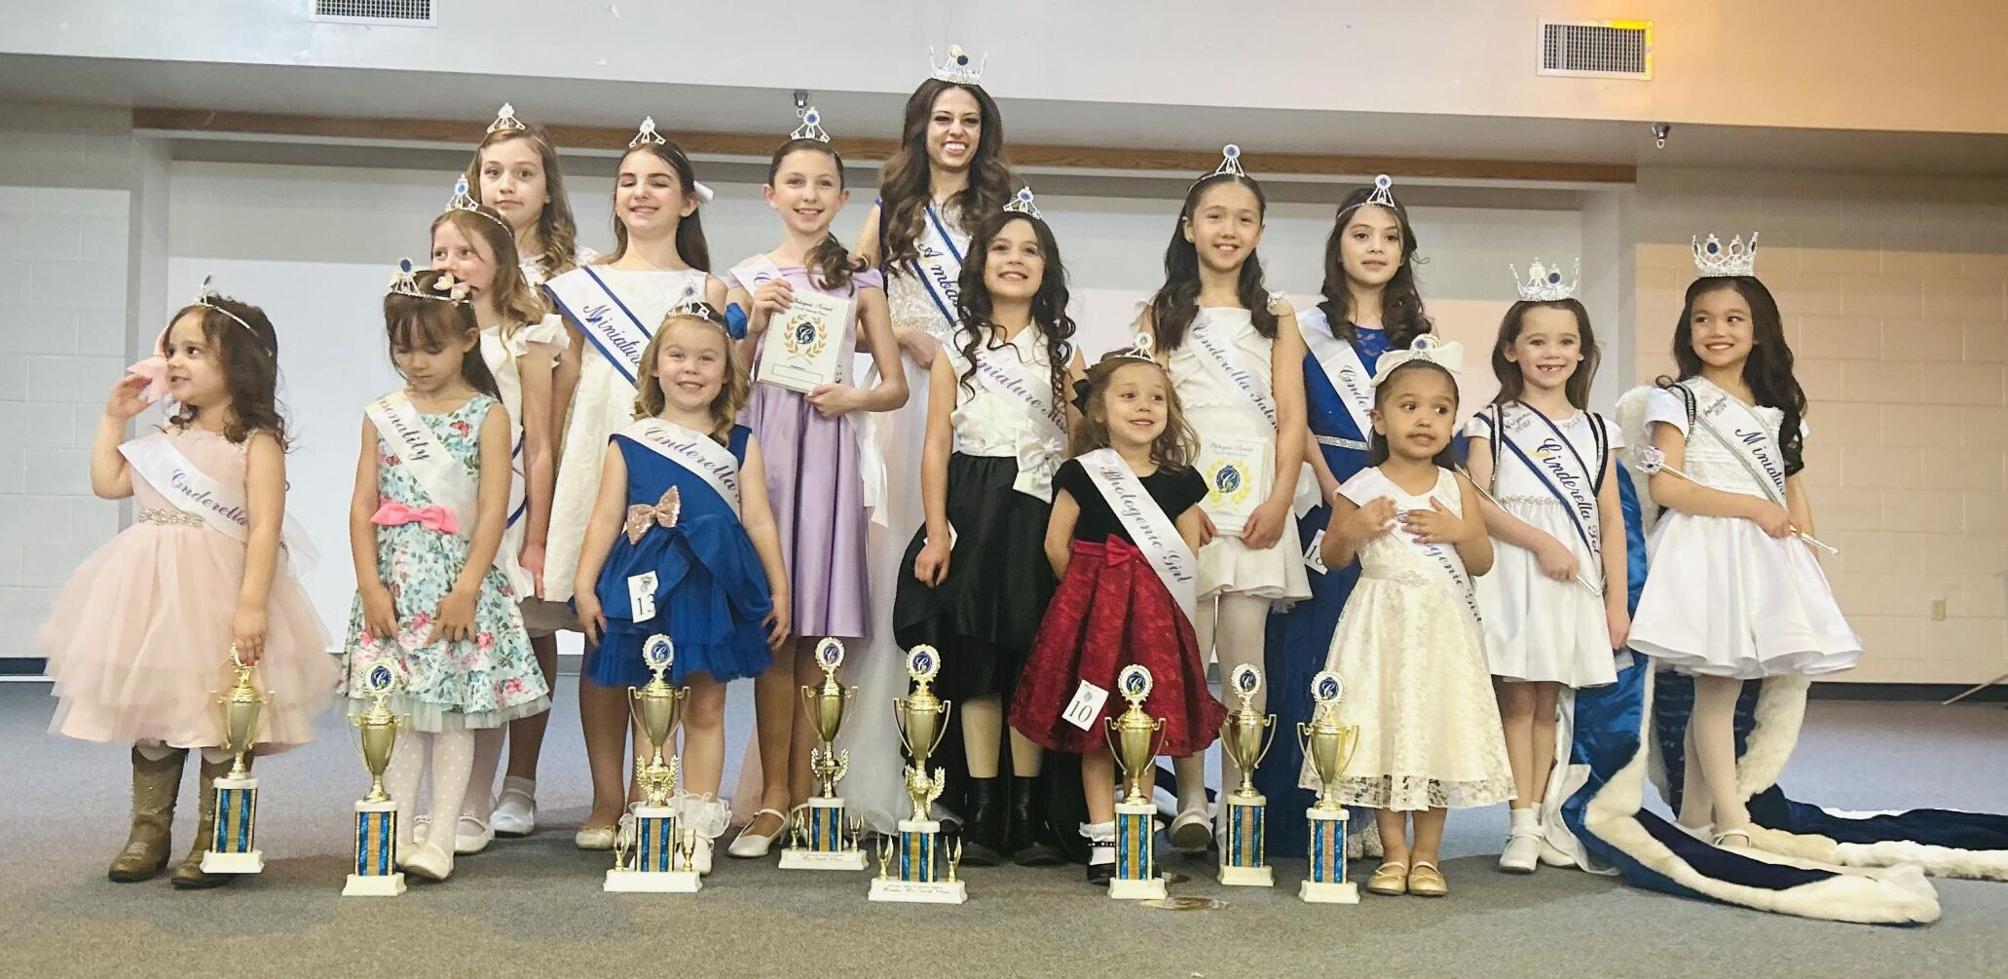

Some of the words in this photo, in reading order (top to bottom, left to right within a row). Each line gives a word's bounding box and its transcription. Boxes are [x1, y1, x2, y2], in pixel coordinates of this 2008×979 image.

[975, 350, 1042, 408] iniature
[1192, 322, 1250, 390] Cinderella
[644, 426, 737, 491] Cinderella
[1536, 438, 1592, 520] Cinderella
[171, 468, 249, 527] Cinderella
[1101, 464, 1162, 547] Photogenic
[1162, 549, 1192, 583] Girl
[1424, 543, 1464, 587] genic
[1069, 700, 1093, 722] 10
